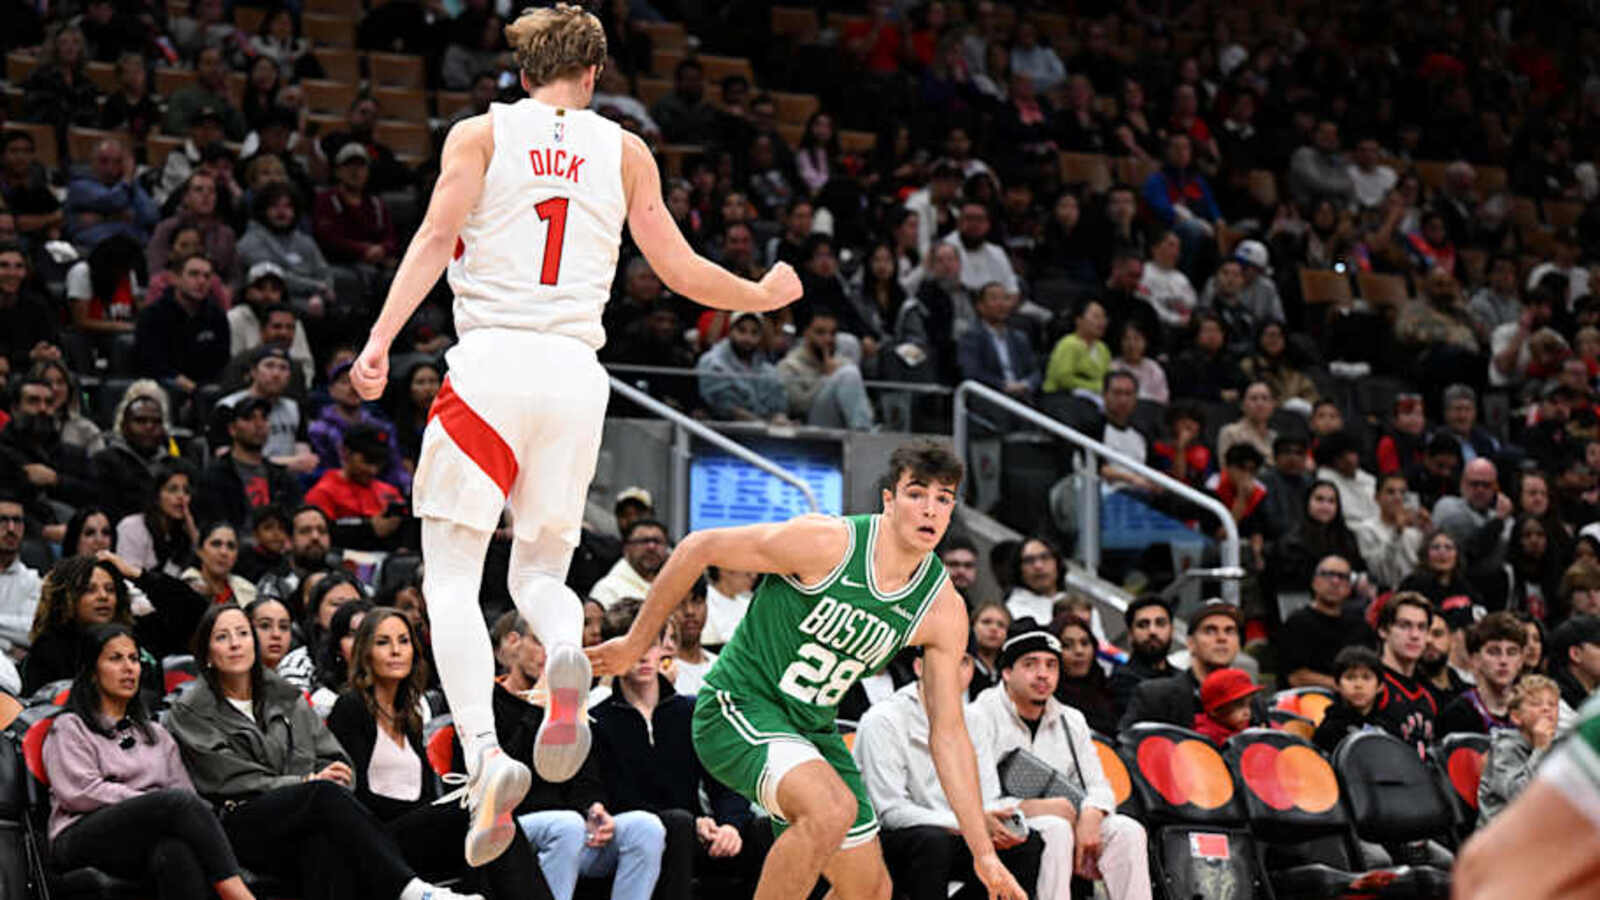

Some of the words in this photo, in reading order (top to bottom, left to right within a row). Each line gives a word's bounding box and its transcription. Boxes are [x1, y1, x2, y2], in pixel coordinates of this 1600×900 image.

[529, 148, 585, 183] DICK
[533, 196, 569, 286] 1
[798, 596, 901, 669] BOSTON
[778, 642, 866, 706] 28
